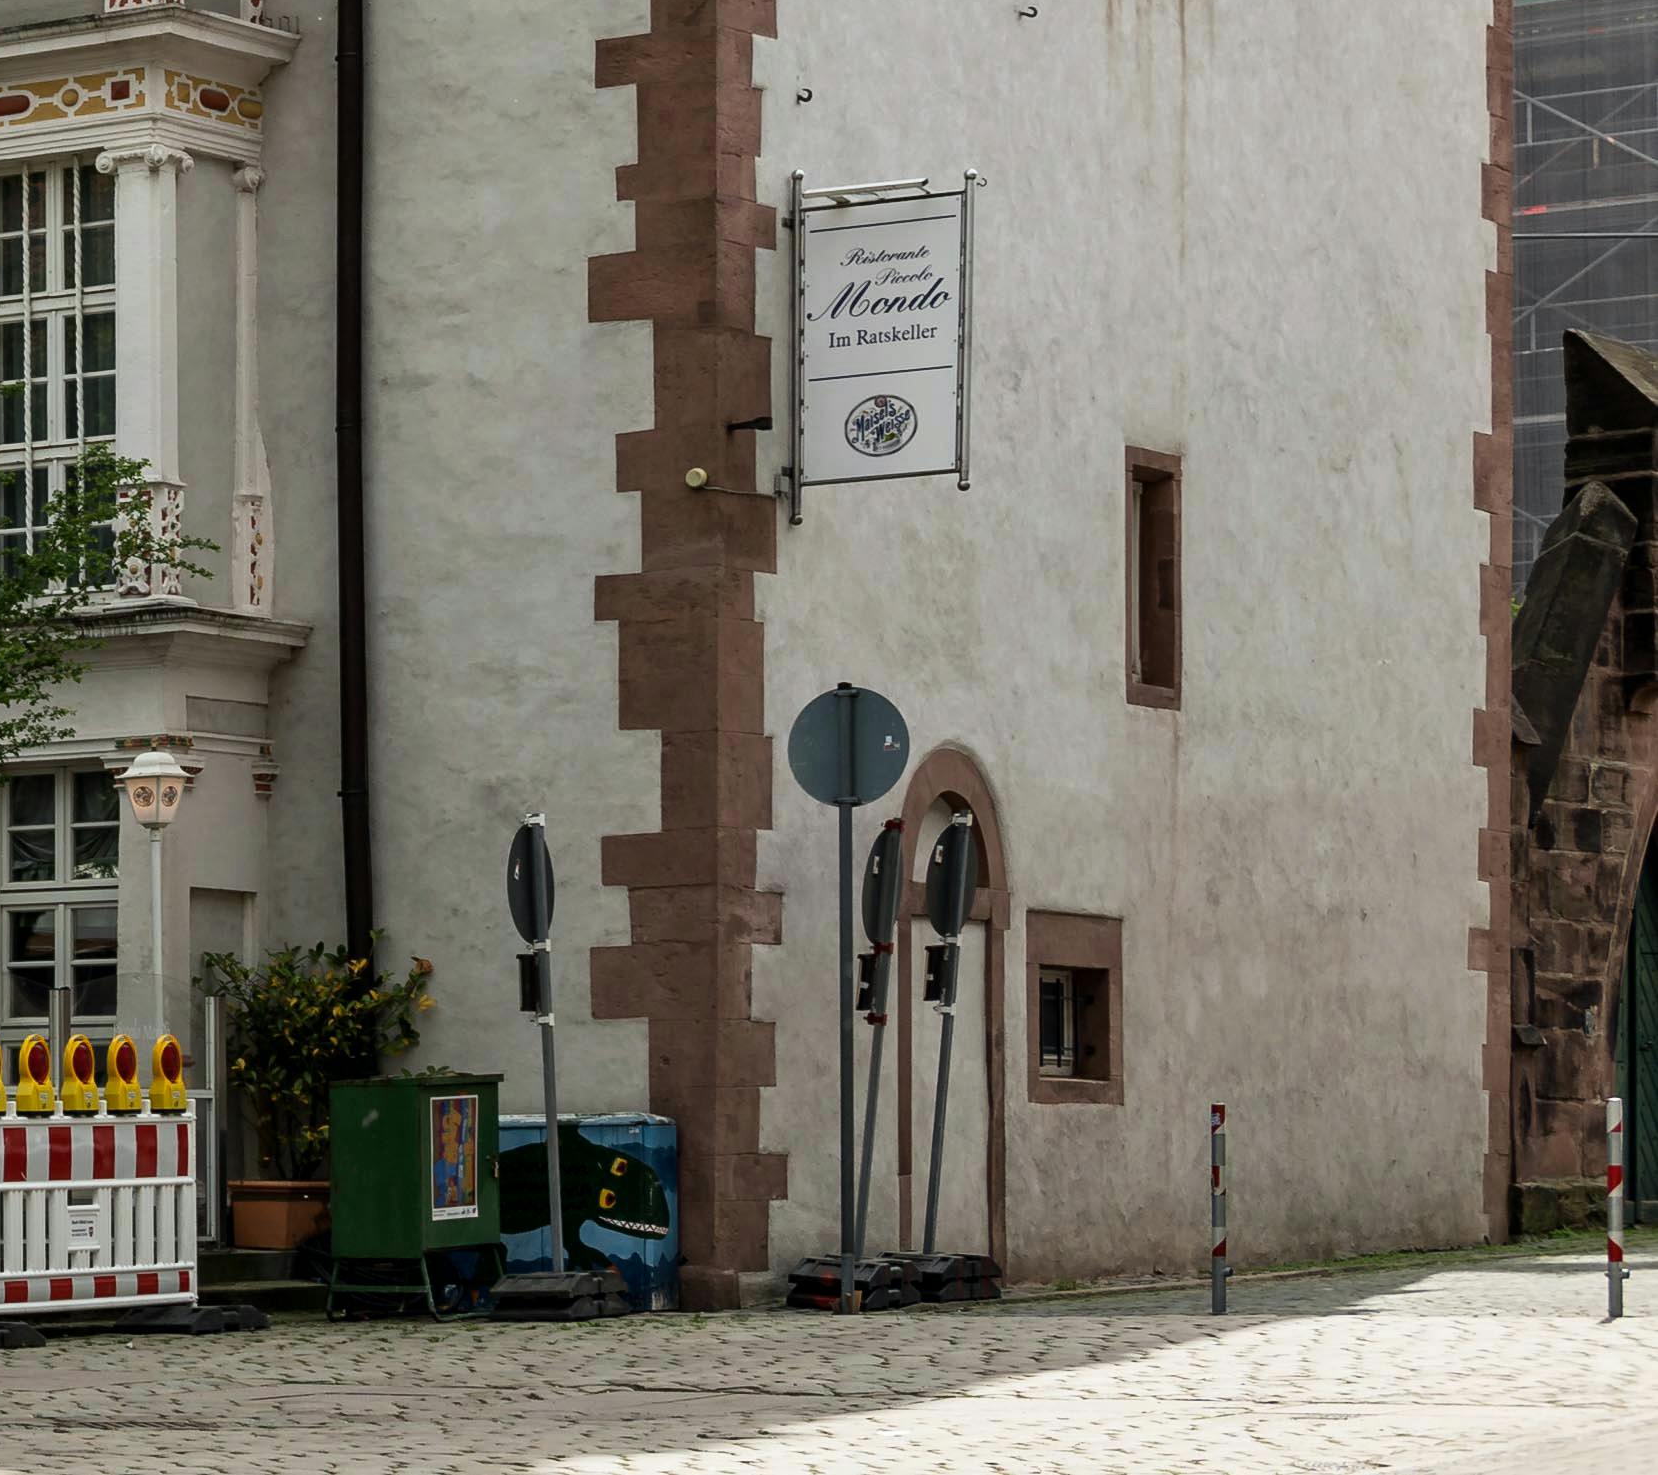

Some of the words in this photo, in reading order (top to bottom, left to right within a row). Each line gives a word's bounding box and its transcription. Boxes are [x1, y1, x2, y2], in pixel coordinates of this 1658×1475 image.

[839, 245, 932, 267] Ristorante
[874, 264, 934, 286] Piccolo
[806, 277, 953, 322] Mondo
[828, 332, 851, 349] Im
[856, 323, 939, 346] Ratskeller
[851, 396, 897, 444] Maisel's
[869, 409, 911, 443] Weisse
